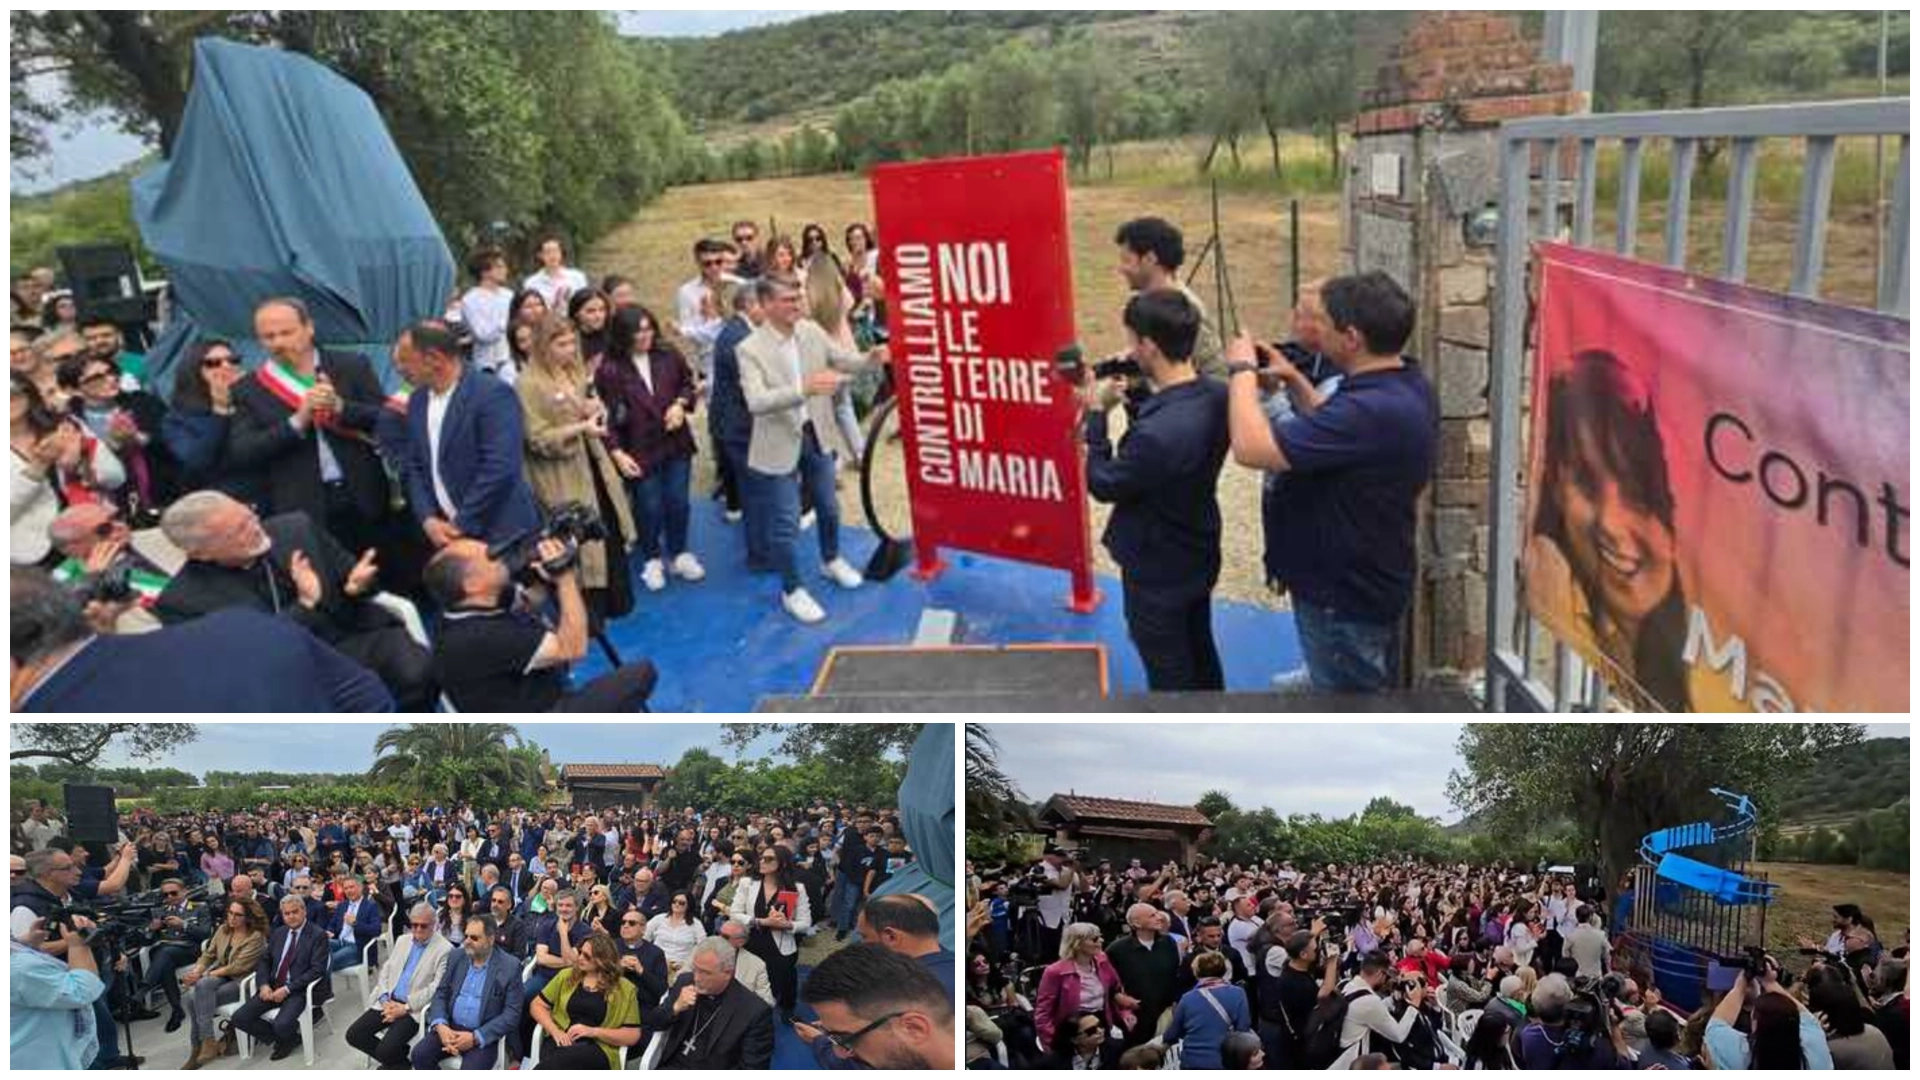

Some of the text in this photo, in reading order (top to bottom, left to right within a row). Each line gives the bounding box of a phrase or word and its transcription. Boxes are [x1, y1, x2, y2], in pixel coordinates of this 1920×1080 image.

[937, 242, 1011, 304] NOI
[944, 310, 980, 353] LE
[896, 244, 954, 485] CONTROLLIAMO
[947, 357, 1053, 404] TERRE
[954, 403, 985, 443] DI
[959, 450, 1063, 501] MARIA
[1705, 413, 1910, 567] Cont
[1681, 604, 1810, 713] Ma
